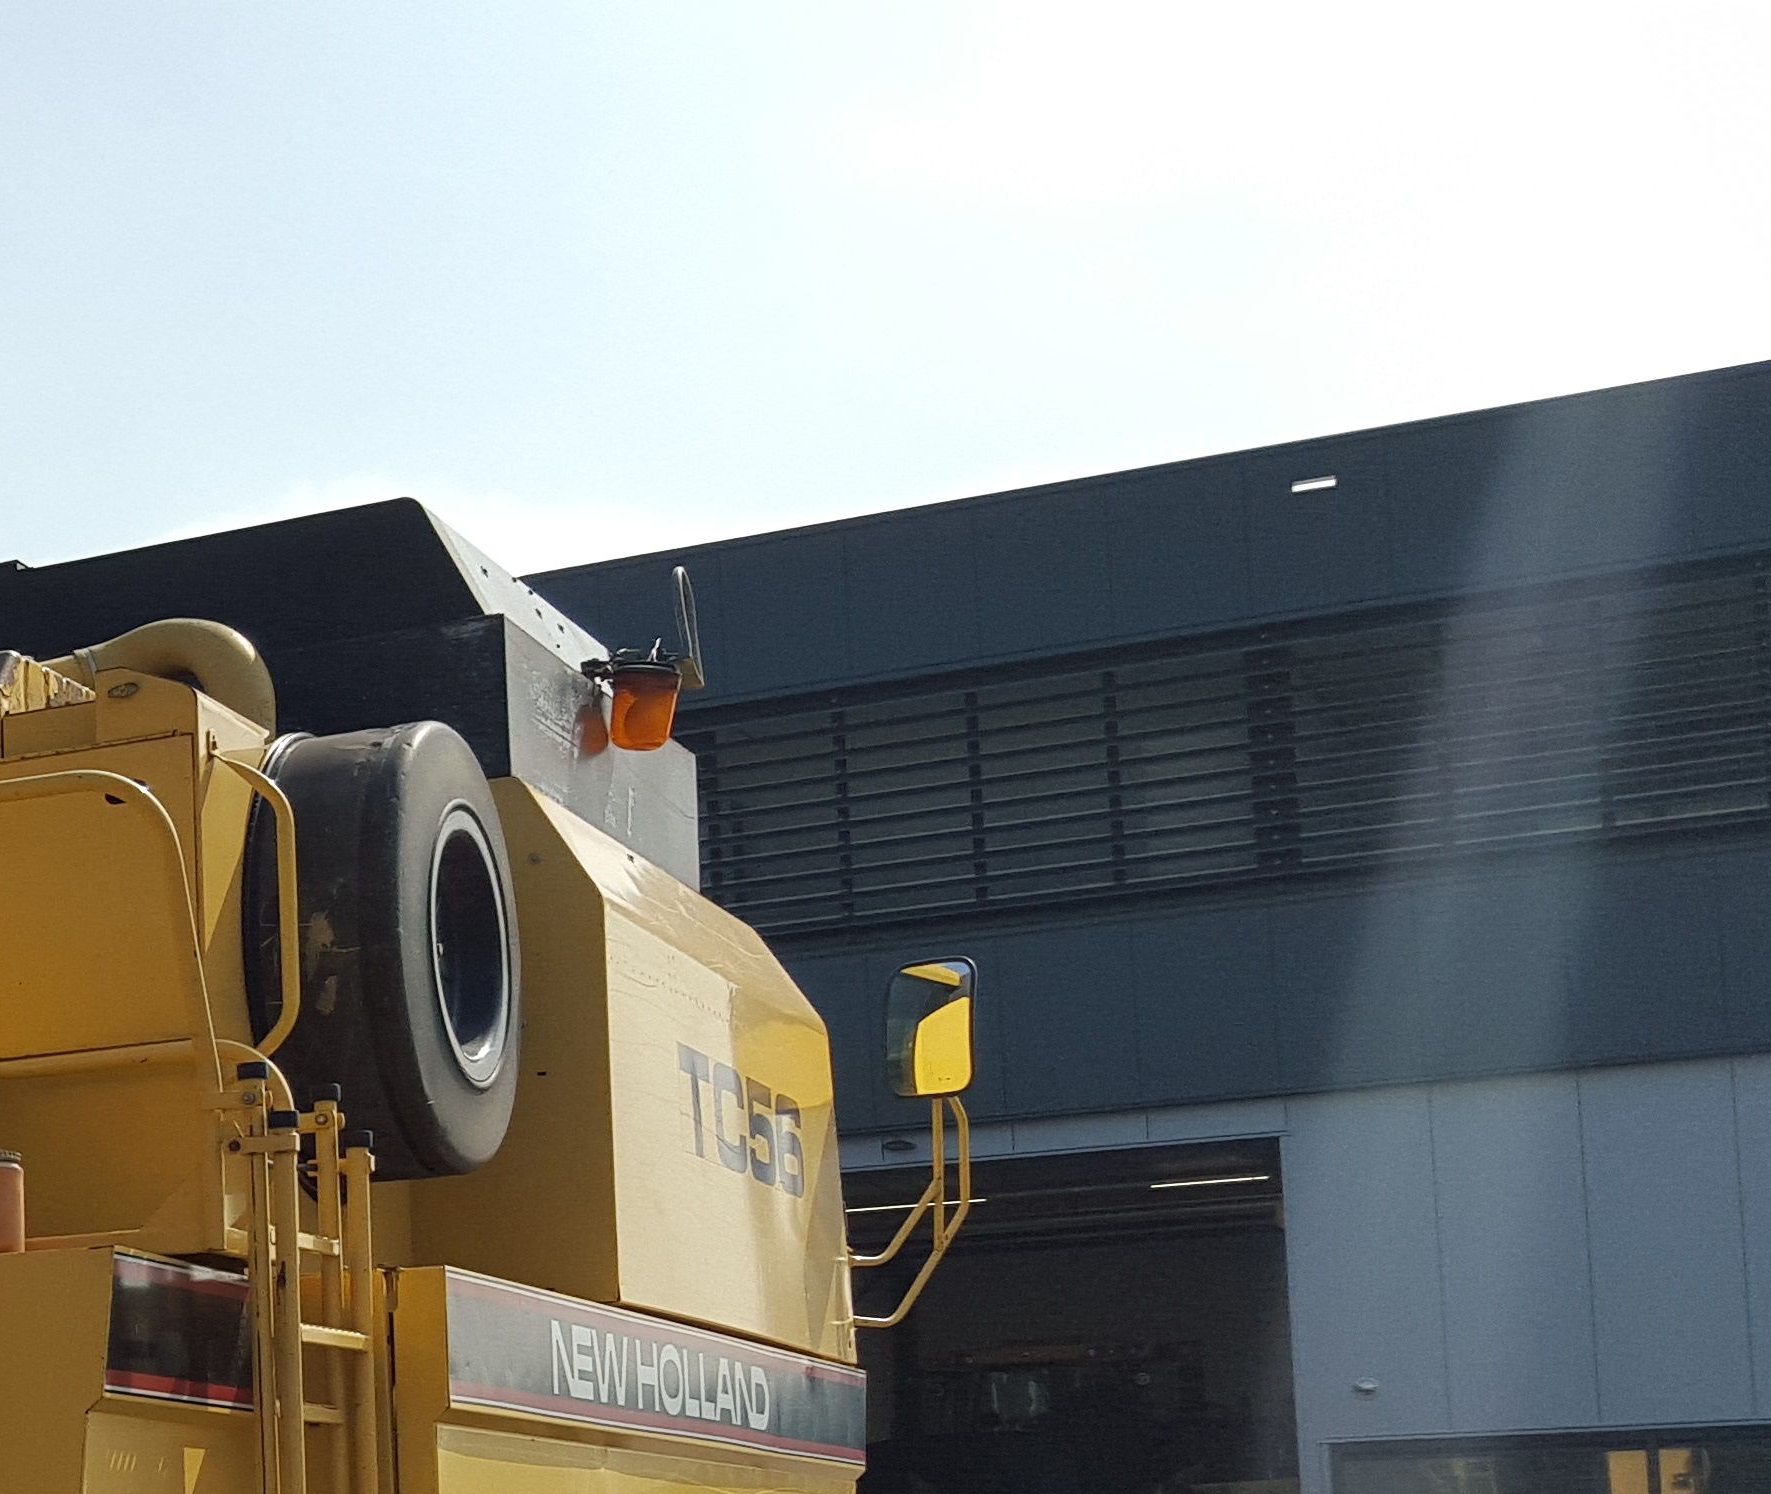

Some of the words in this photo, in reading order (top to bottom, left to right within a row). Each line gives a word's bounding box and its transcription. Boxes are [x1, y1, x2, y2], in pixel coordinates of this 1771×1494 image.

[676, 1040, 805, 1199] TC56
[550, 1319, 629, 1407] NEW
[635, 1337, 771, 1431] HOLLAND
